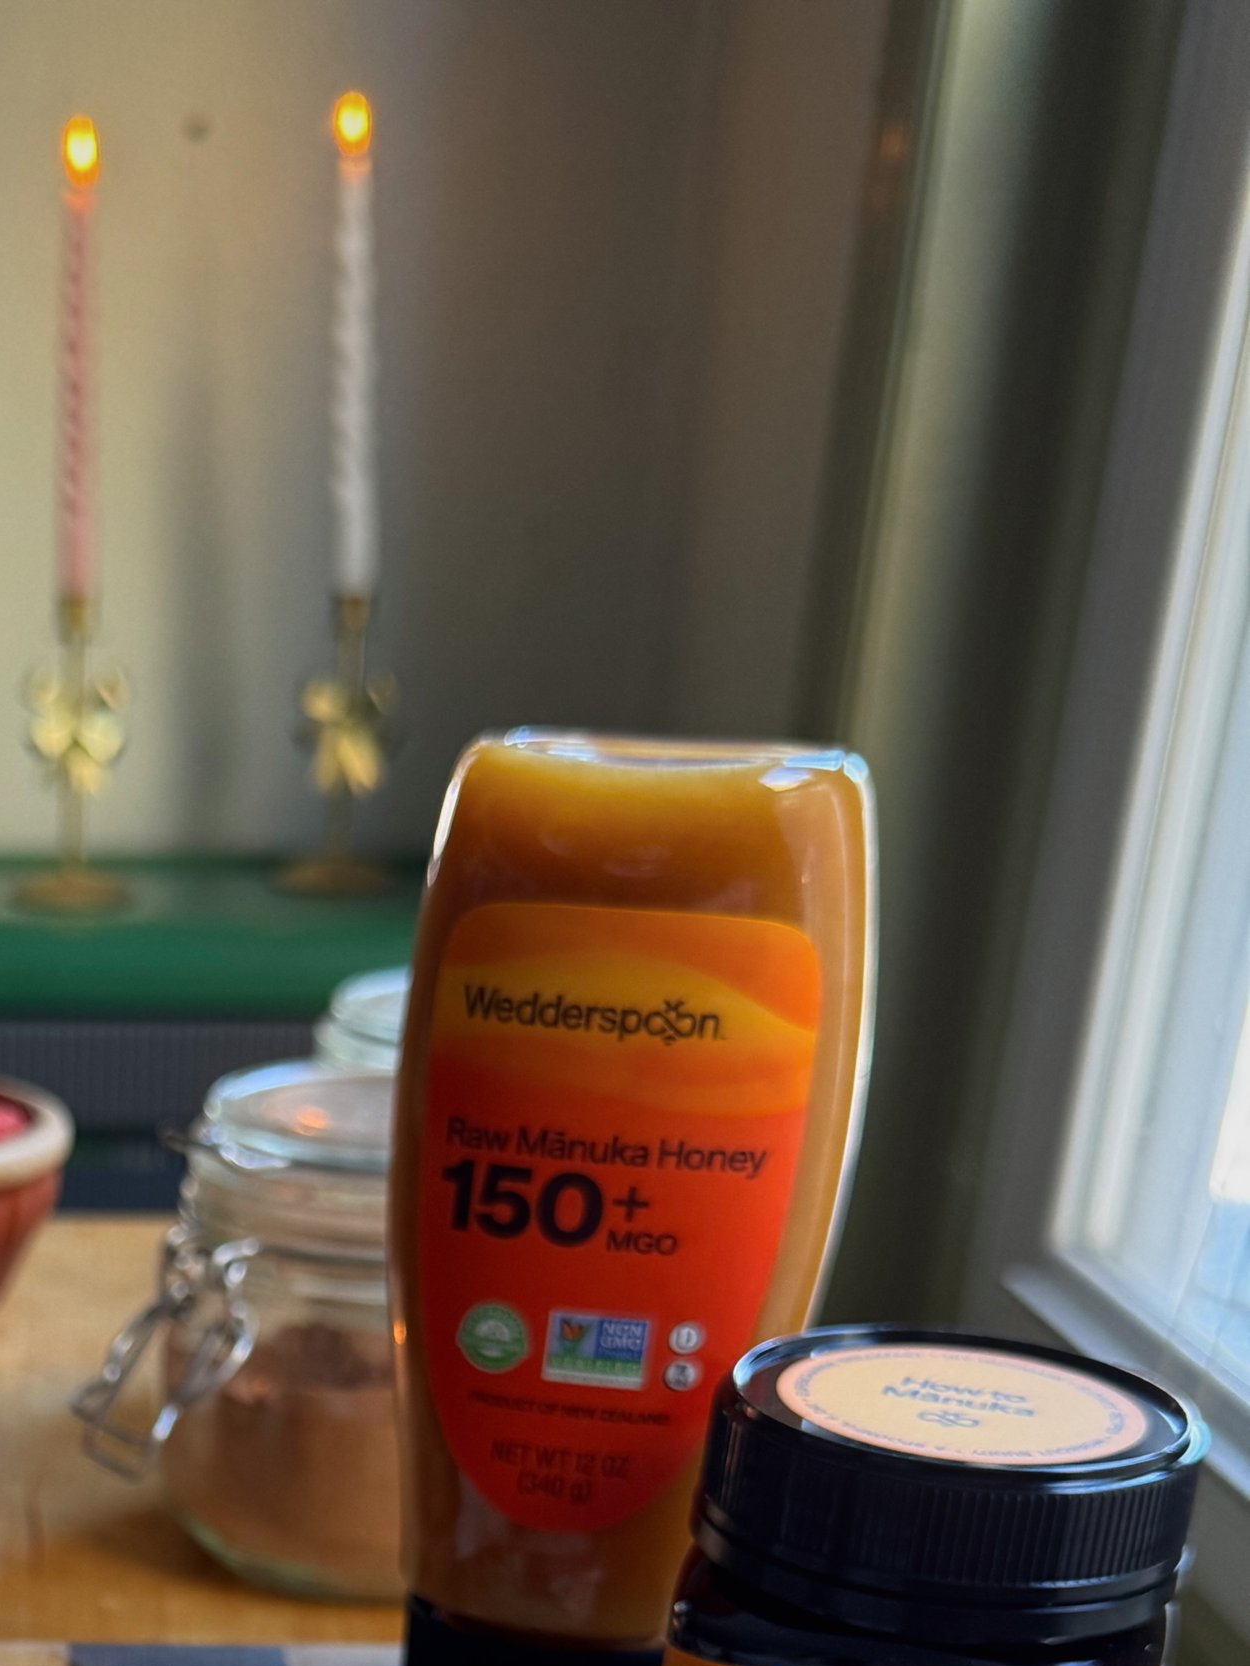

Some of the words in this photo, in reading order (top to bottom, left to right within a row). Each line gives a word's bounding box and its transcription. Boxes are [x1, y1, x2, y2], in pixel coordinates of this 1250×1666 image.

[463, 985, 720, 1045] Wedderspoon
[447, 1117, 507, 1151] Raw
[658, 1139, 767, 1180] Honey
[607, 1229, 678, 1256] MGO
[901, 1376, 983, 1396] How
[990, 1390, 1028, 1403] to
[491, 1439, 533, 1467] NET
[536, 1446, 572, 1470] WT
